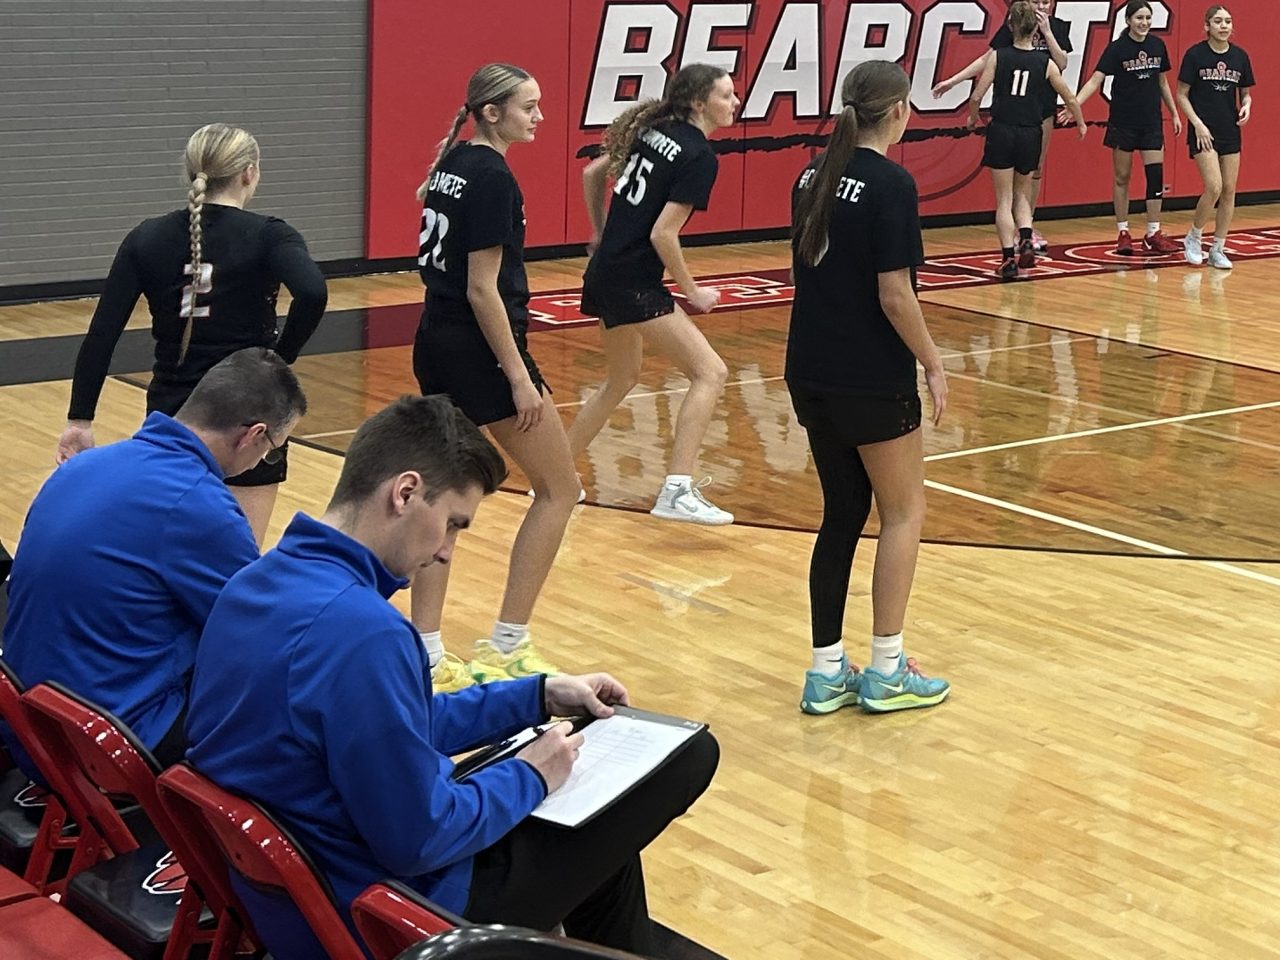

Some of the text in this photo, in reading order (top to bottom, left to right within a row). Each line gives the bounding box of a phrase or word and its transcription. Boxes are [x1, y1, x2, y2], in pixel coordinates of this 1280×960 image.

[1010, 69, 1030, 97] 11
[613, 152, 655, 206] 15
[418, 208, 450, 272] 22
[180, 262, 213, 318] 2
